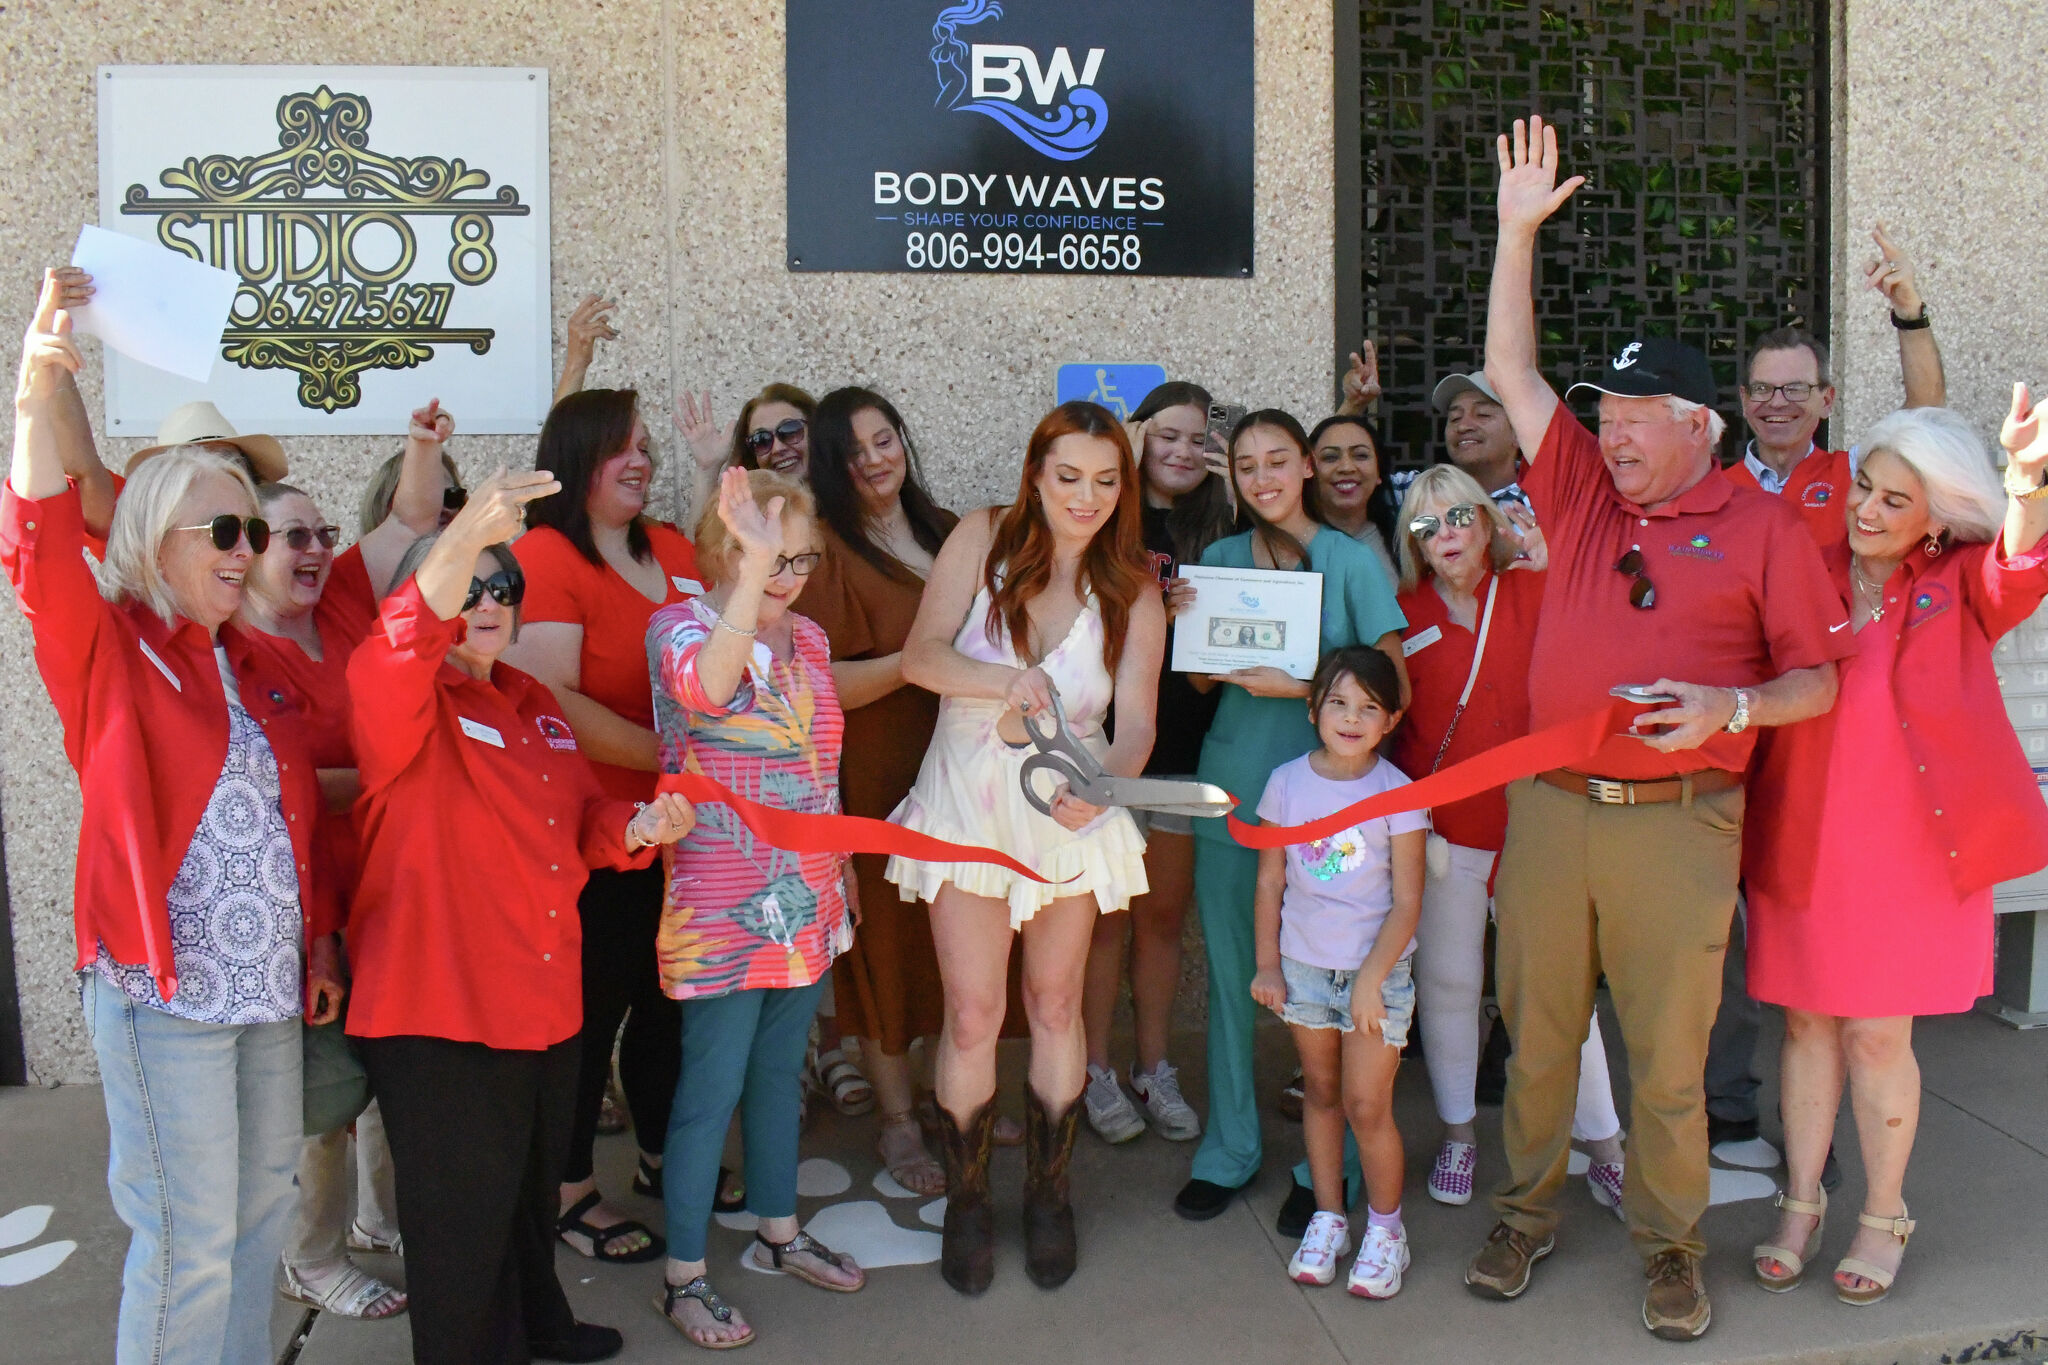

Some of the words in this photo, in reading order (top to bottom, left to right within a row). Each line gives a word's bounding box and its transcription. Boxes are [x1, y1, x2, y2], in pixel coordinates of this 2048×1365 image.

[971, 43, 1105, 105] BW
[874, 171, 997, 205] BODY
[1006, 174, 1165, 211] WAVES
[904, 211, 965, 227] SHAPE
[969, 212, 1018, 228] YOUR
[1023, 213, 1137, 230] CONFIDENCE
[157, 211, 418, 286] STUDIO
[448, 212, 497, 286] 8
[906, 232, 1141, 270] 806-994-6658
[228, 282, 455, 330] 06.292.5627
